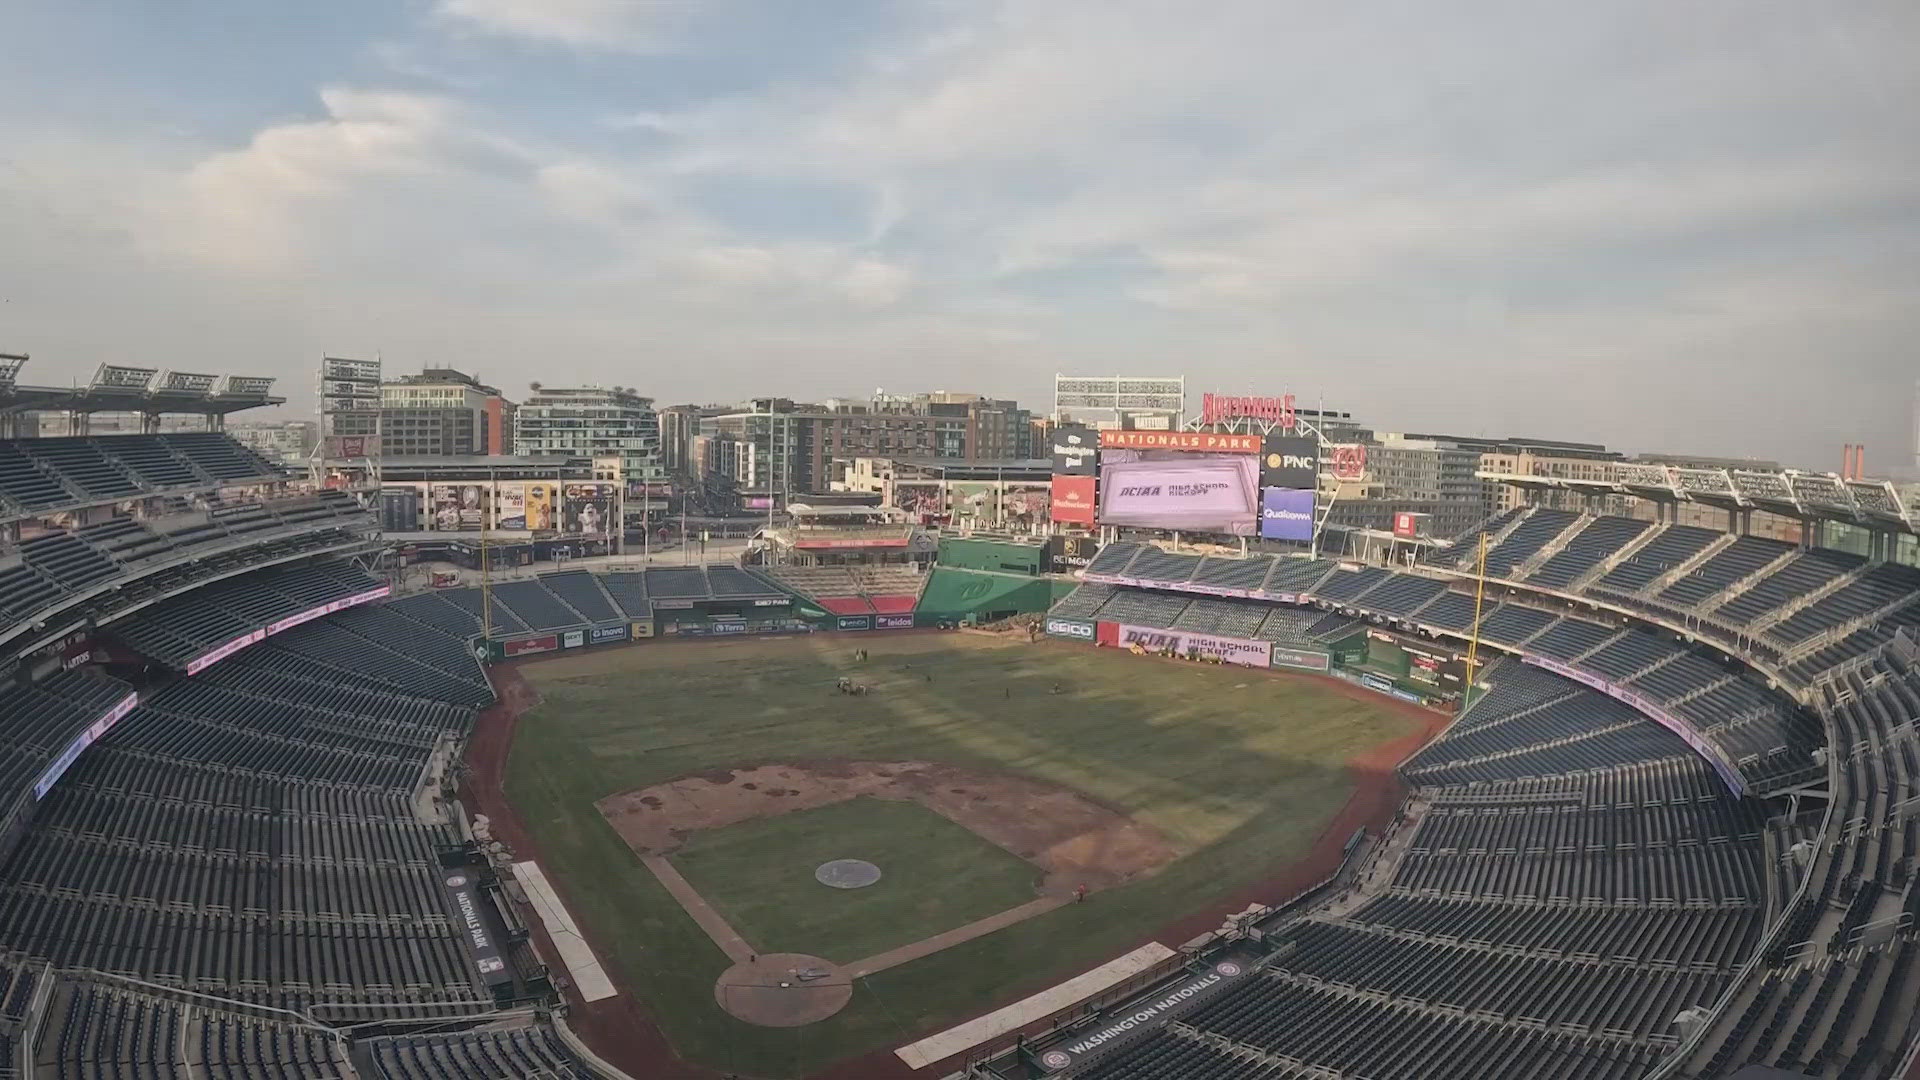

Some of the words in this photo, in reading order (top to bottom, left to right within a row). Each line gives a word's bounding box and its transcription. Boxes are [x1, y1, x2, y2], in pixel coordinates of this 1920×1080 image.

[1203, 393, 1296, 428] NATIONALS
[1106, 433, 1200, 447] NATIONALS
[1207, 437, 1252, 449] PARK
[1283, 455, 1314, 469] PNC
[1053, 499, 1092, 510] Budweiser
[1264, 508, 1311, 521] Qualcomm
[724, 624, 745, 632] Terra
[887, 617, 912, 627] leidos
[1048, 621, 1093, 636] GEICO
[601, 627, 624, 637] Inova
[1124, 629, 1182, 650] DCIAA
[1188, 637, 1218, 647] HIGH
[1219, 641, 1266, 654] SCHOOL
[1186, 644, 1238, 657] KICKOFF
[455, 891, 480, 929] NATIONALS
[470, 928, 489, 949] PARK
[1068, 1007, 1160, 1055] WASHINGTON
[1155, 973, 1221, 1012] NATIONALS
